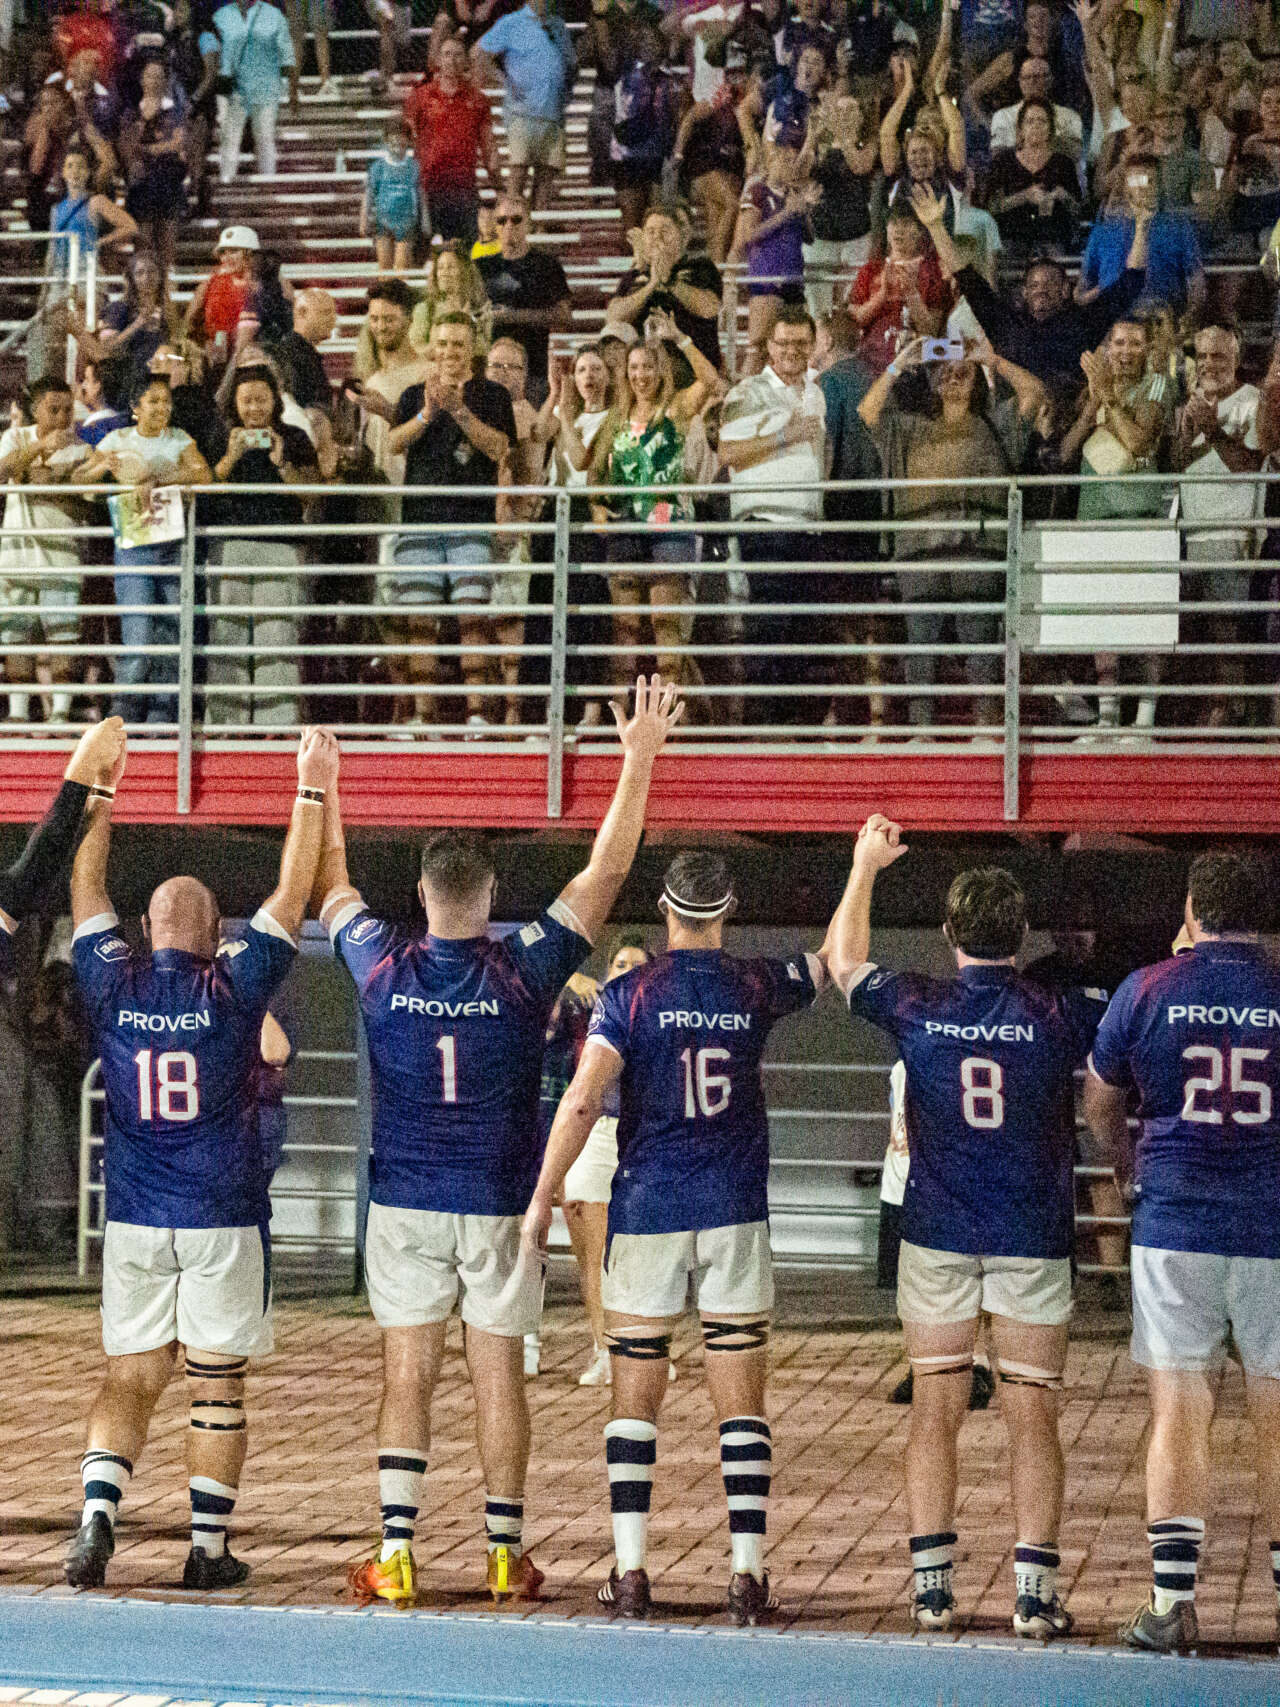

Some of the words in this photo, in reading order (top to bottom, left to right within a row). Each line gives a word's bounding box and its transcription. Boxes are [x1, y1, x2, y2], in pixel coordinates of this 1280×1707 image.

[118, 1010, 210, 1032] PROVEN
[391, 994, 498, 1017] PROVEN
[659, 1011, 750, 1030] PROVEN
[1167, 1004, 1280, 1027] PROVEN
[925, 1021, 1033, 1041] PROVEN
[134, 1050, 198, 1120] 18
[436, 1036, 456, 1102] 1
[681, 1048, 731, 1118] 16
[1181, 1046, 1272, 1124] 25
[961, 1057, 1003, 1128] 8
